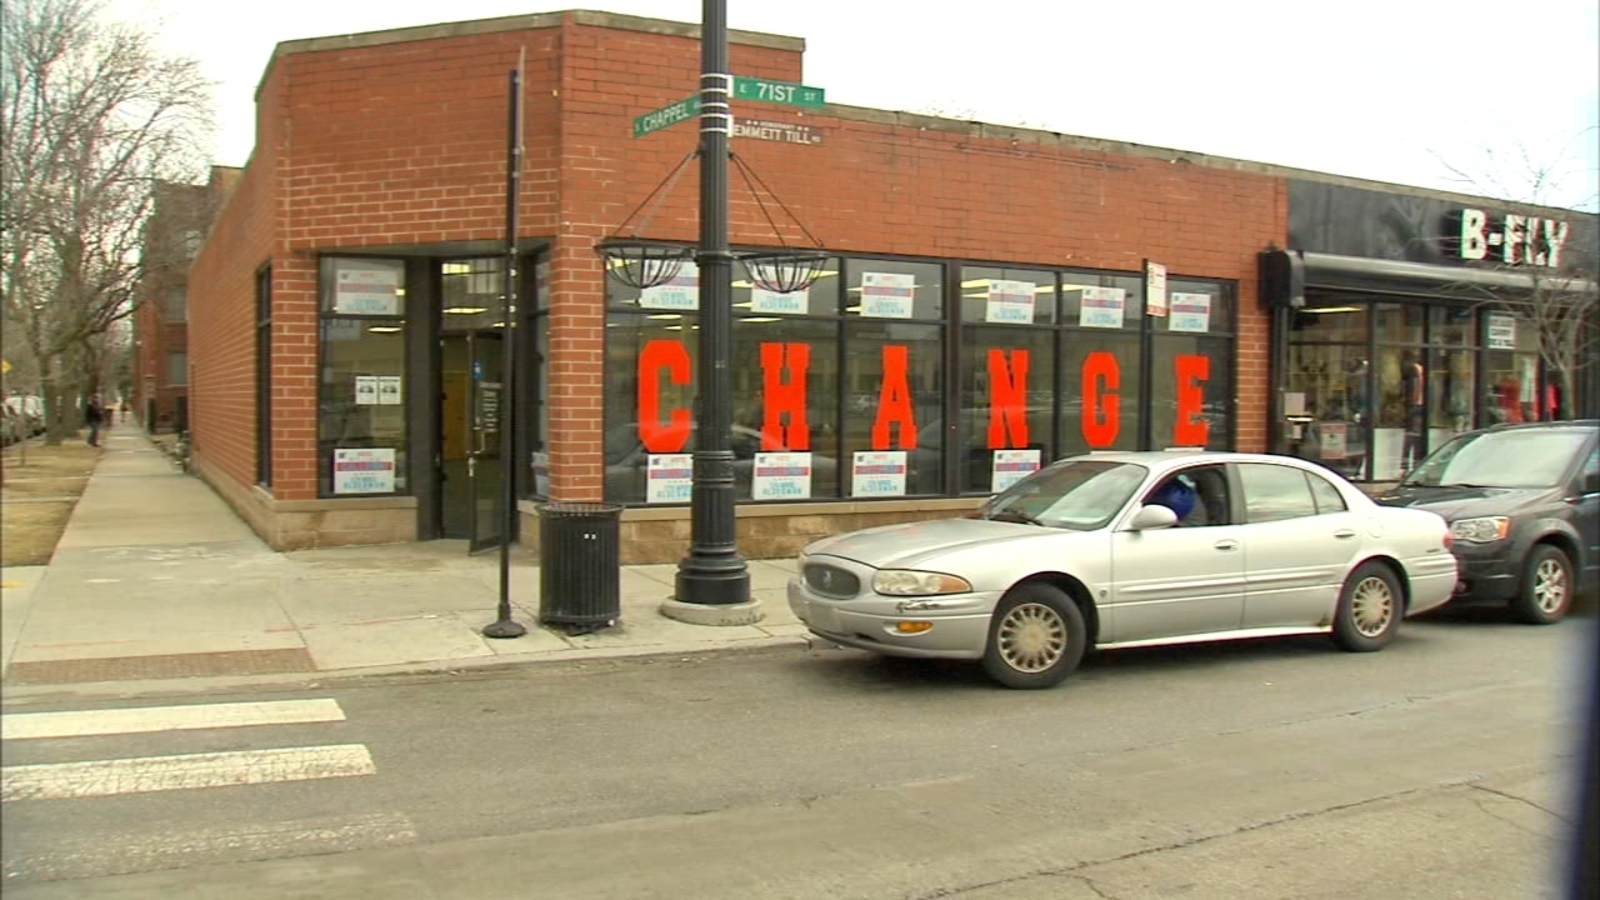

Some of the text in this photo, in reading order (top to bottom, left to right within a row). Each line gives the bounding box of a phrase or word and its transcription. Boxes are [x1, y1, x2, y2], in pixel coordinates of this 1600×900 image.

[756, 82, 796, 103] 71ST
[643, 102, 690, 132] CHAPPEL
[733, 124, 782, 141] EMMETT
[785, 130, 812, 144] TILL
[638, 339, 1210, 453] CHANGE
